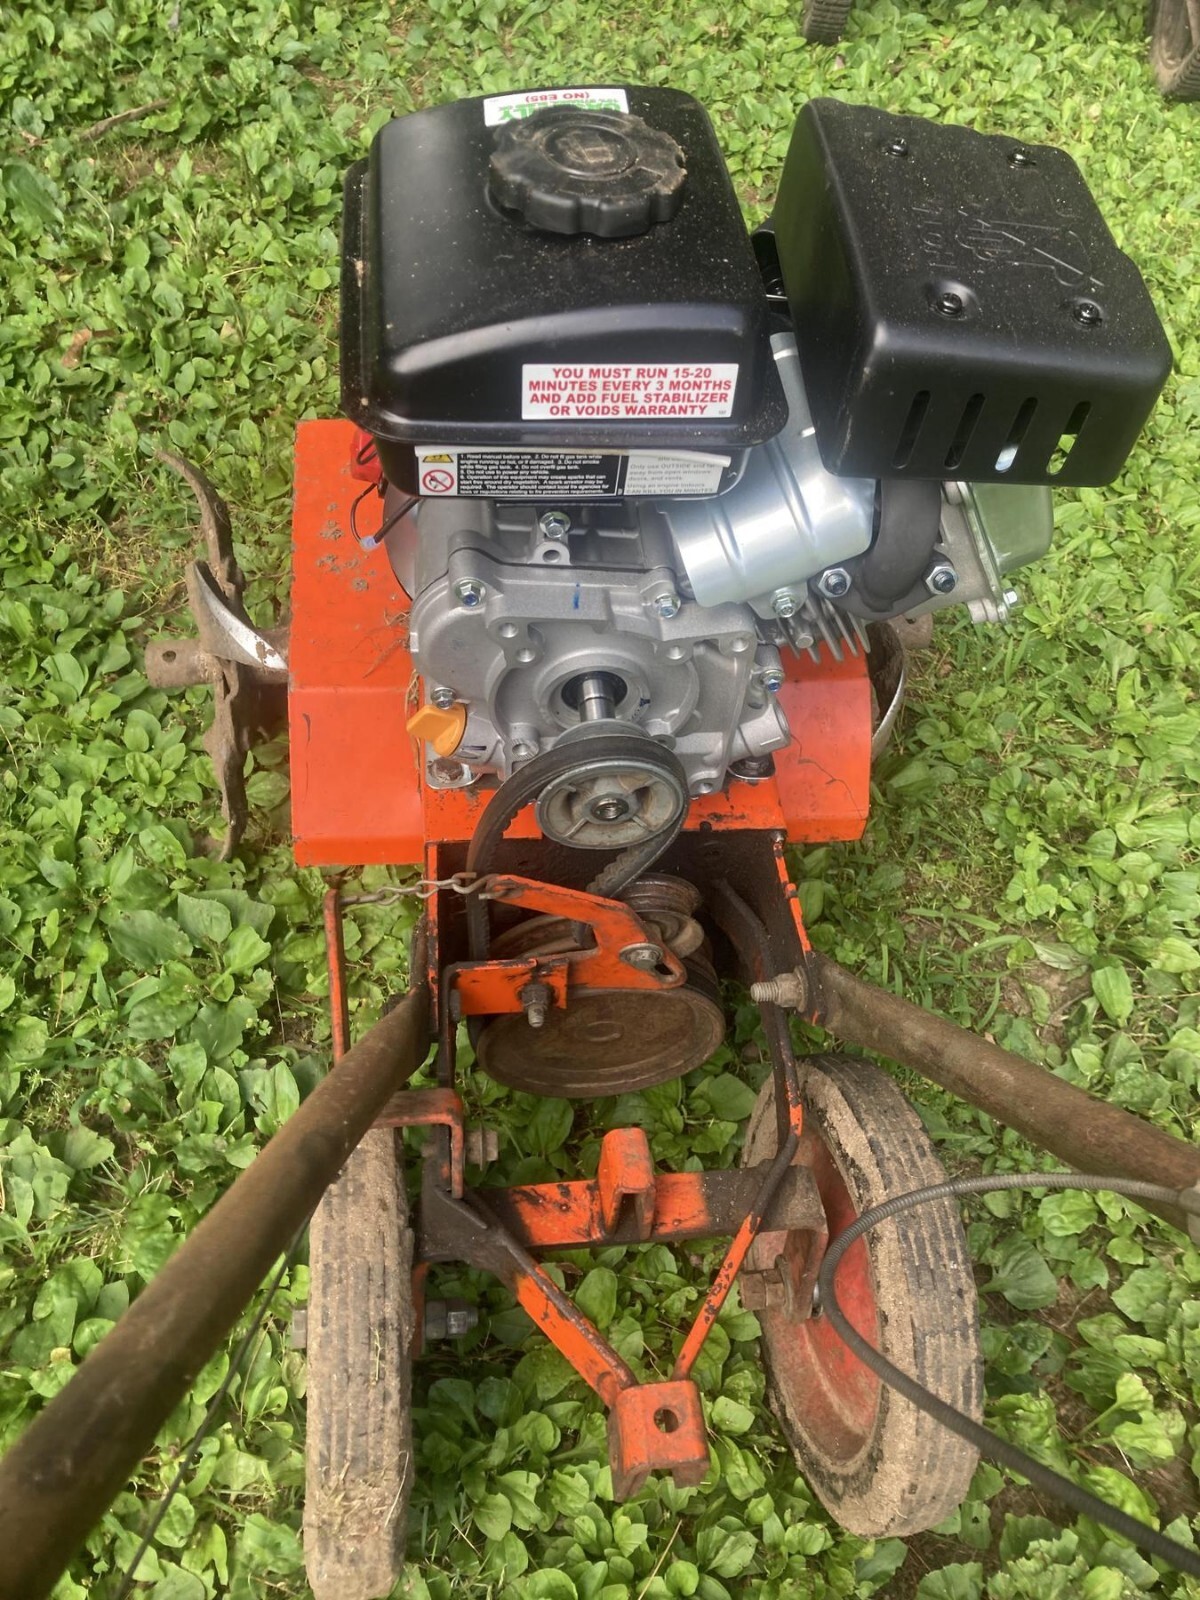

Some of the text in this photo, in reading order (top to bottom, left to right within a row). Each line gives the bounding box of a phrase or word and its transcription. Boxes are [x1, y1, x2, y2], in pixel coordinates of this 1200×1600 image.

[525, 94, 557, 103] E85)
[552, 368, 712, 378] YOU MUST RUN 15-20
[529, 380, 732, 391] MINUTES EVERY 3 MONTHS
[530, 393, 729, 403] AND ADD FUEL STABILIZER
[549, 405, 570, 415] OR
[575, 405, 620, 415] VOIDS
[625, 405, 708, 415] WARRANTY
